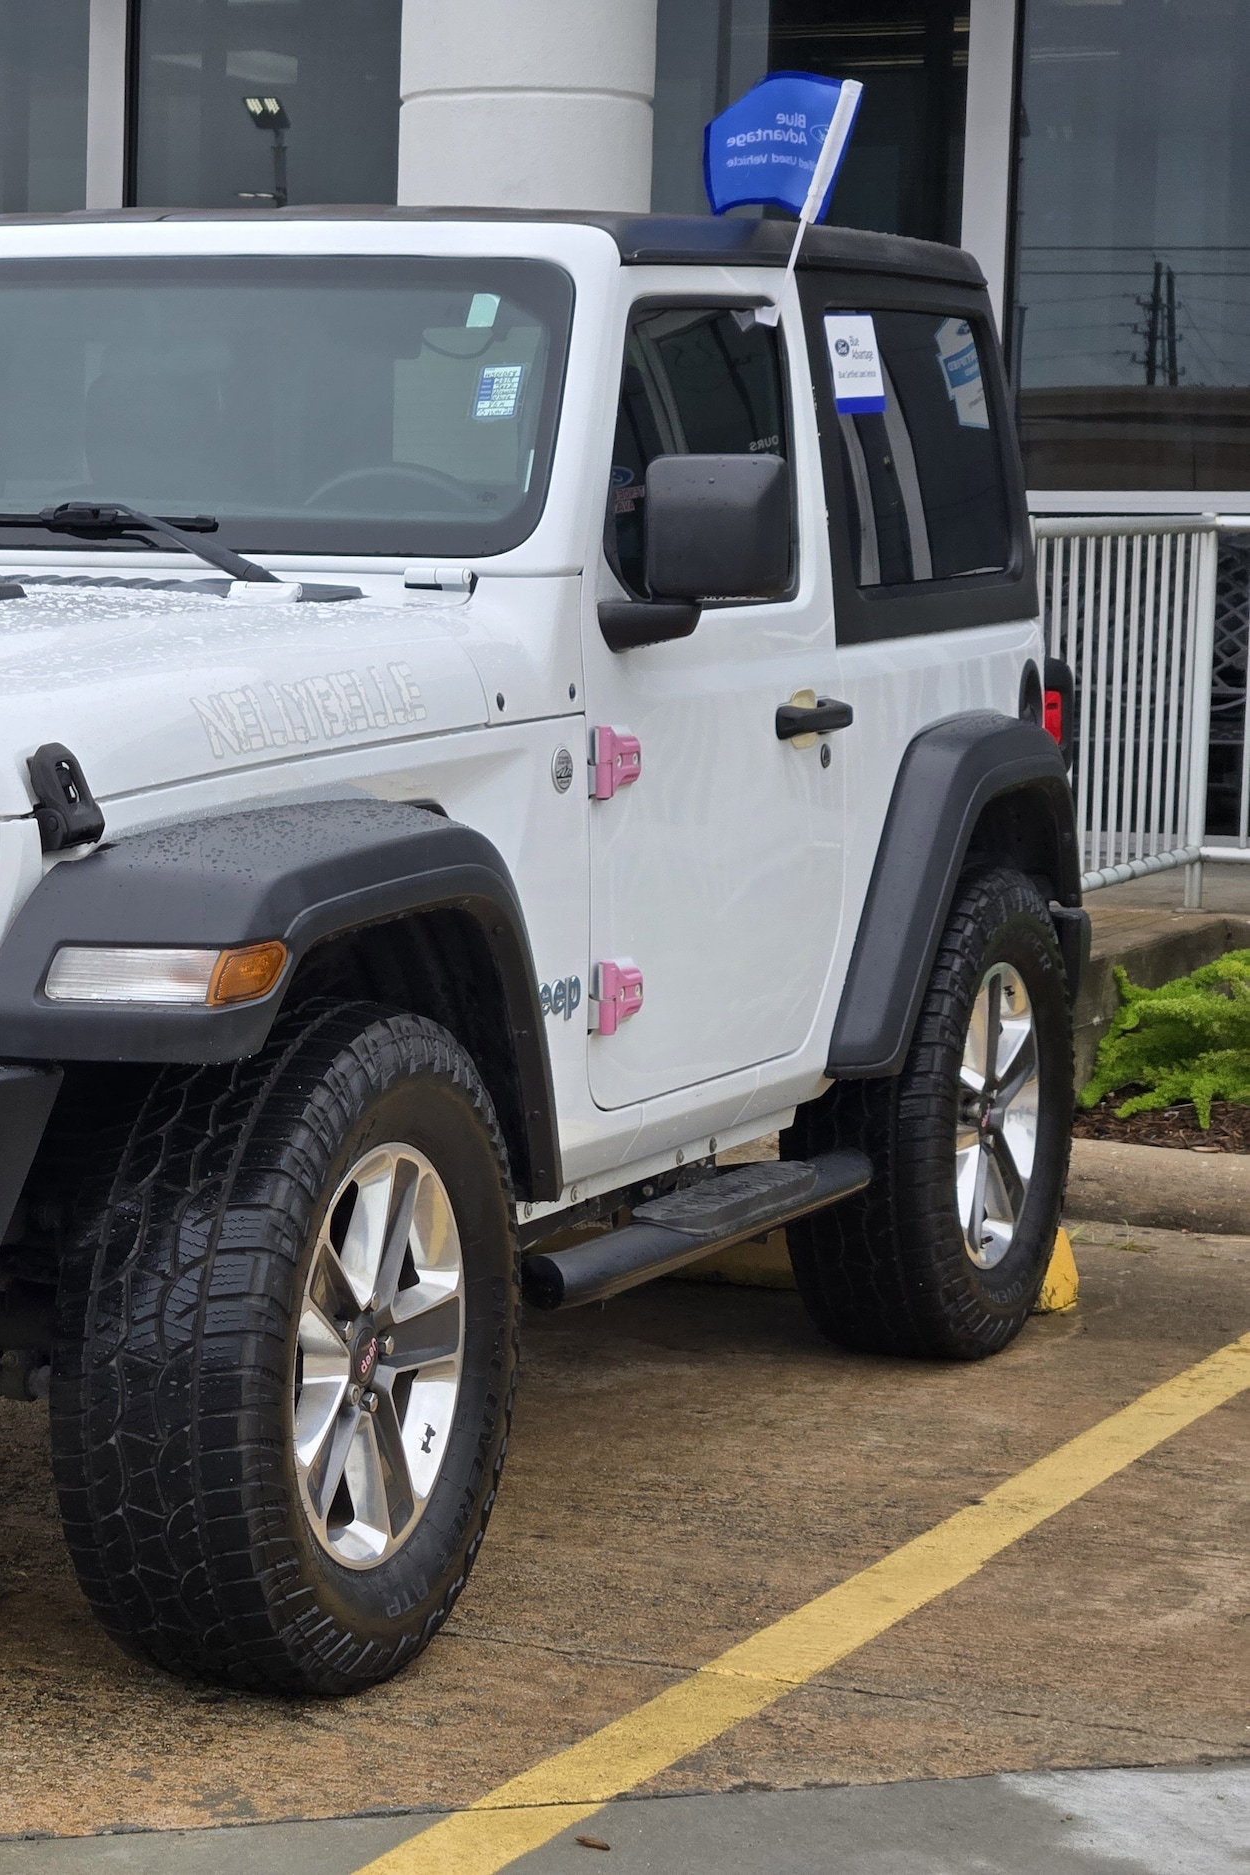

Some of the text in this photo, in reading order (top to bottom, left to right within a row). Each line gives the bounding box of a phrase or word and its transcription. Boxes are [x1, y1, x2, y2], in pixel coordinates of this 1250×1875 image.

[190, 662, 427, 758] NELLYBELLE
[539, 975, 581, 1021] eep
[360, 1337, 378, 1374] Jeep
